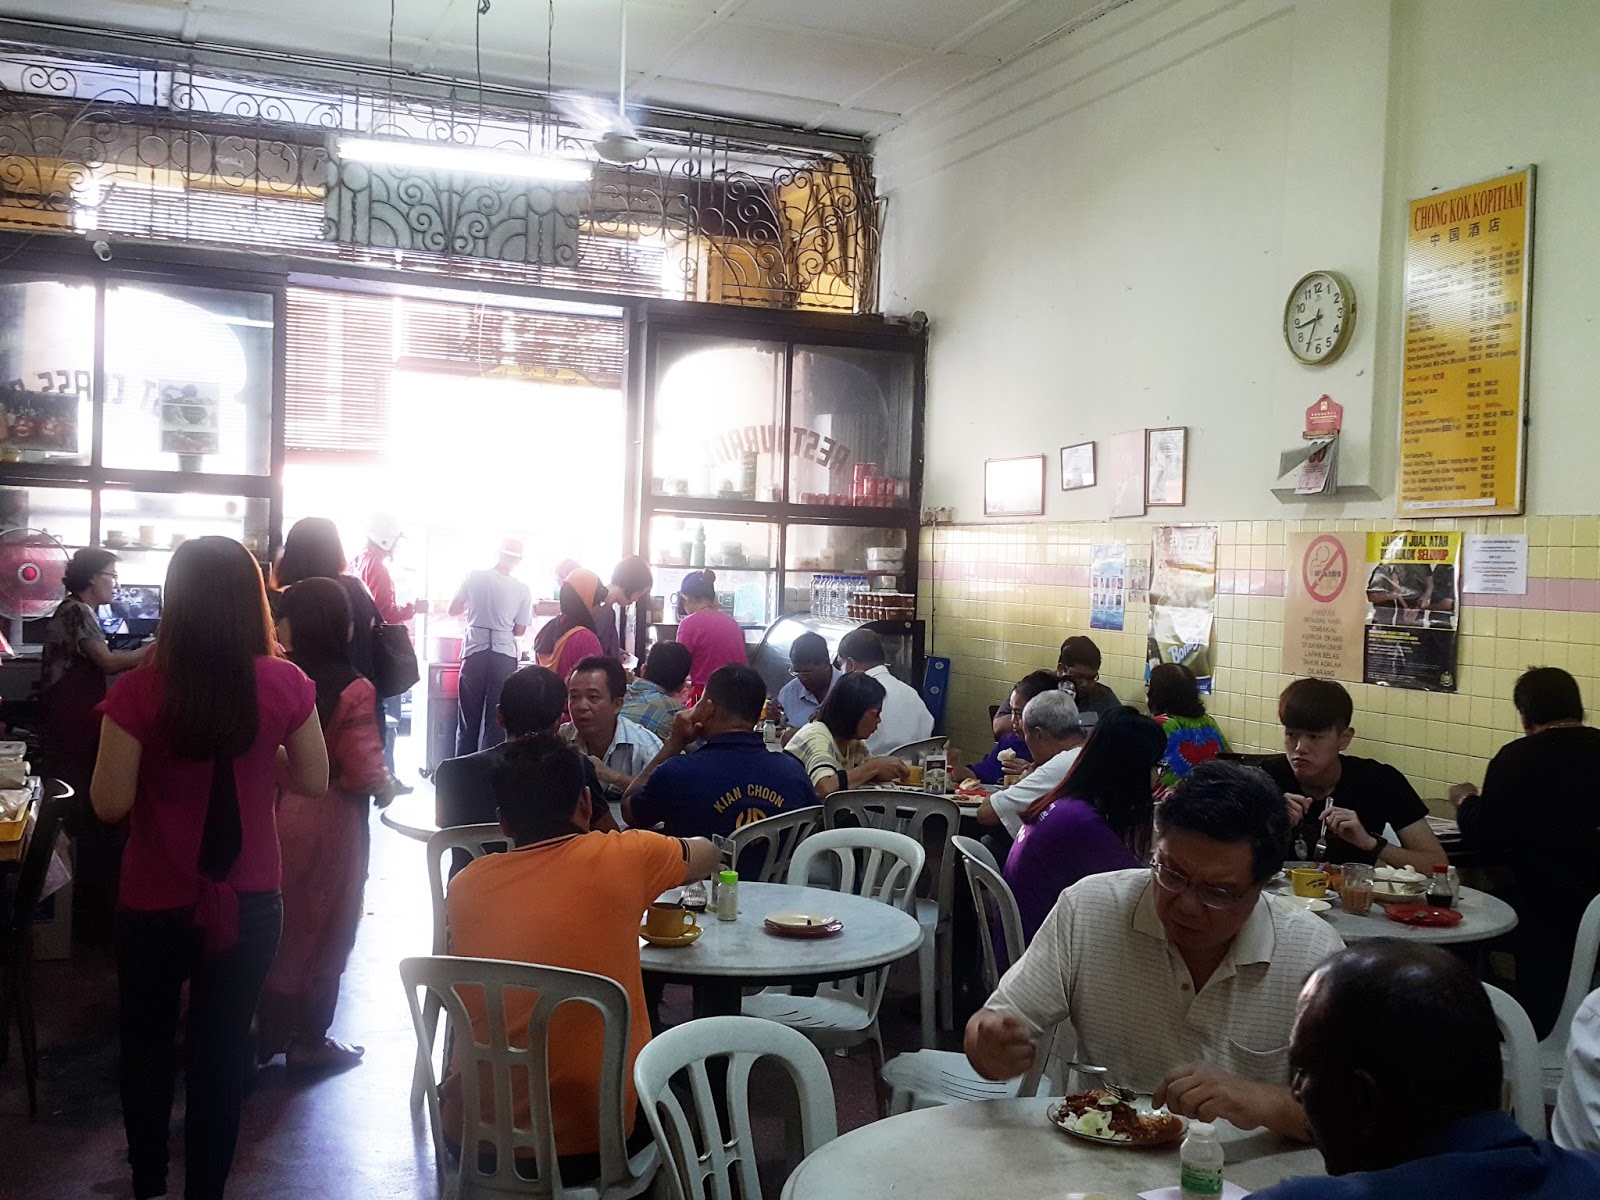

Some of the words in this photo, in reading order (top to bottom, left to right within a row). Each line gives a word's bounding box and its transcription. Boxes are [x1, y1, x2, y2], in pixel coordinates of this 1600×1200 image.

[1414, 201, 1447, 231] CHONG
[1449, 194, 1471, 223] KOK
[1473, 181, 1523, 218] KOPITIAM
[1314, 282, 1322, 293] 12
[1333, 293, 1340, 304] 2
[1297, 303, 1306, 314] 10
[1337, 308, 1343, 318] 3
[1333, 324, 1340, 334] 4
[1298, 332, 1304, 342] 8
[1326, 337, 1332, 347] 5
[1315, 343, 1322, 354] 6
[1409, 535, 1427, 547] JUAL
[713, 786, 742, 813] KIAN
[747, 784, 785, 808] CHOON
